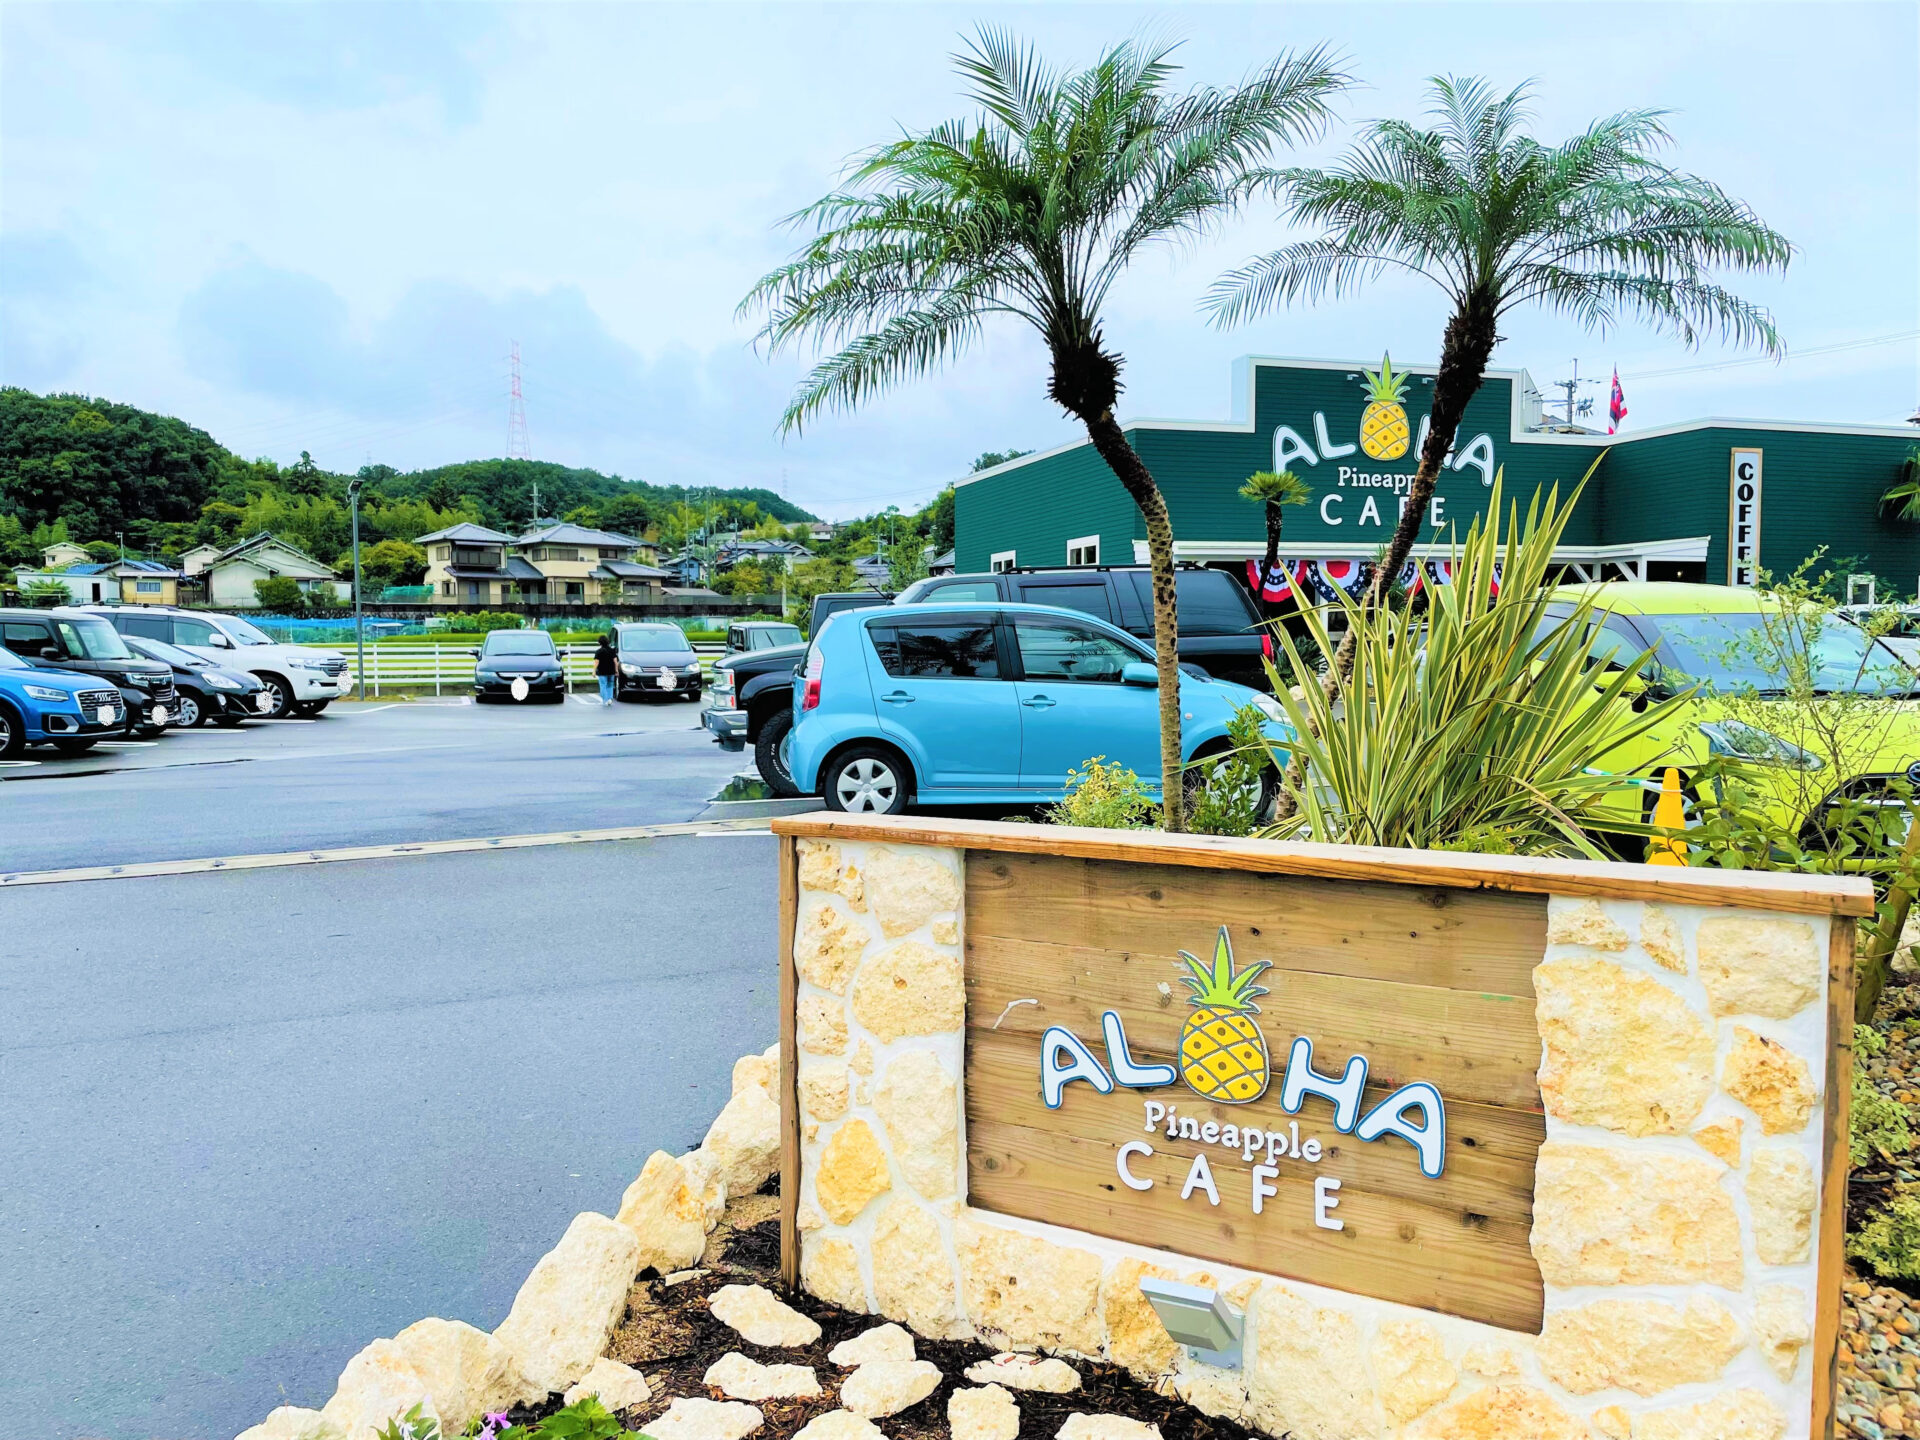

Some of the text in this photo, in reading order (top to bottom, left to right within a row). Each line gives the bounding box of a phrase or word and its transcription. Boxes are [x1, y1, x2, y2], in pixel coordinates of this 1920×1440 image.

[1337, 466, 1418, 495] Pineapp
[1736, 462, 1754, 585] COFFEE
[1143, 1100, 1323, 1167] Pineapple
[1115, 1140, 1345, 1232] CAFE
